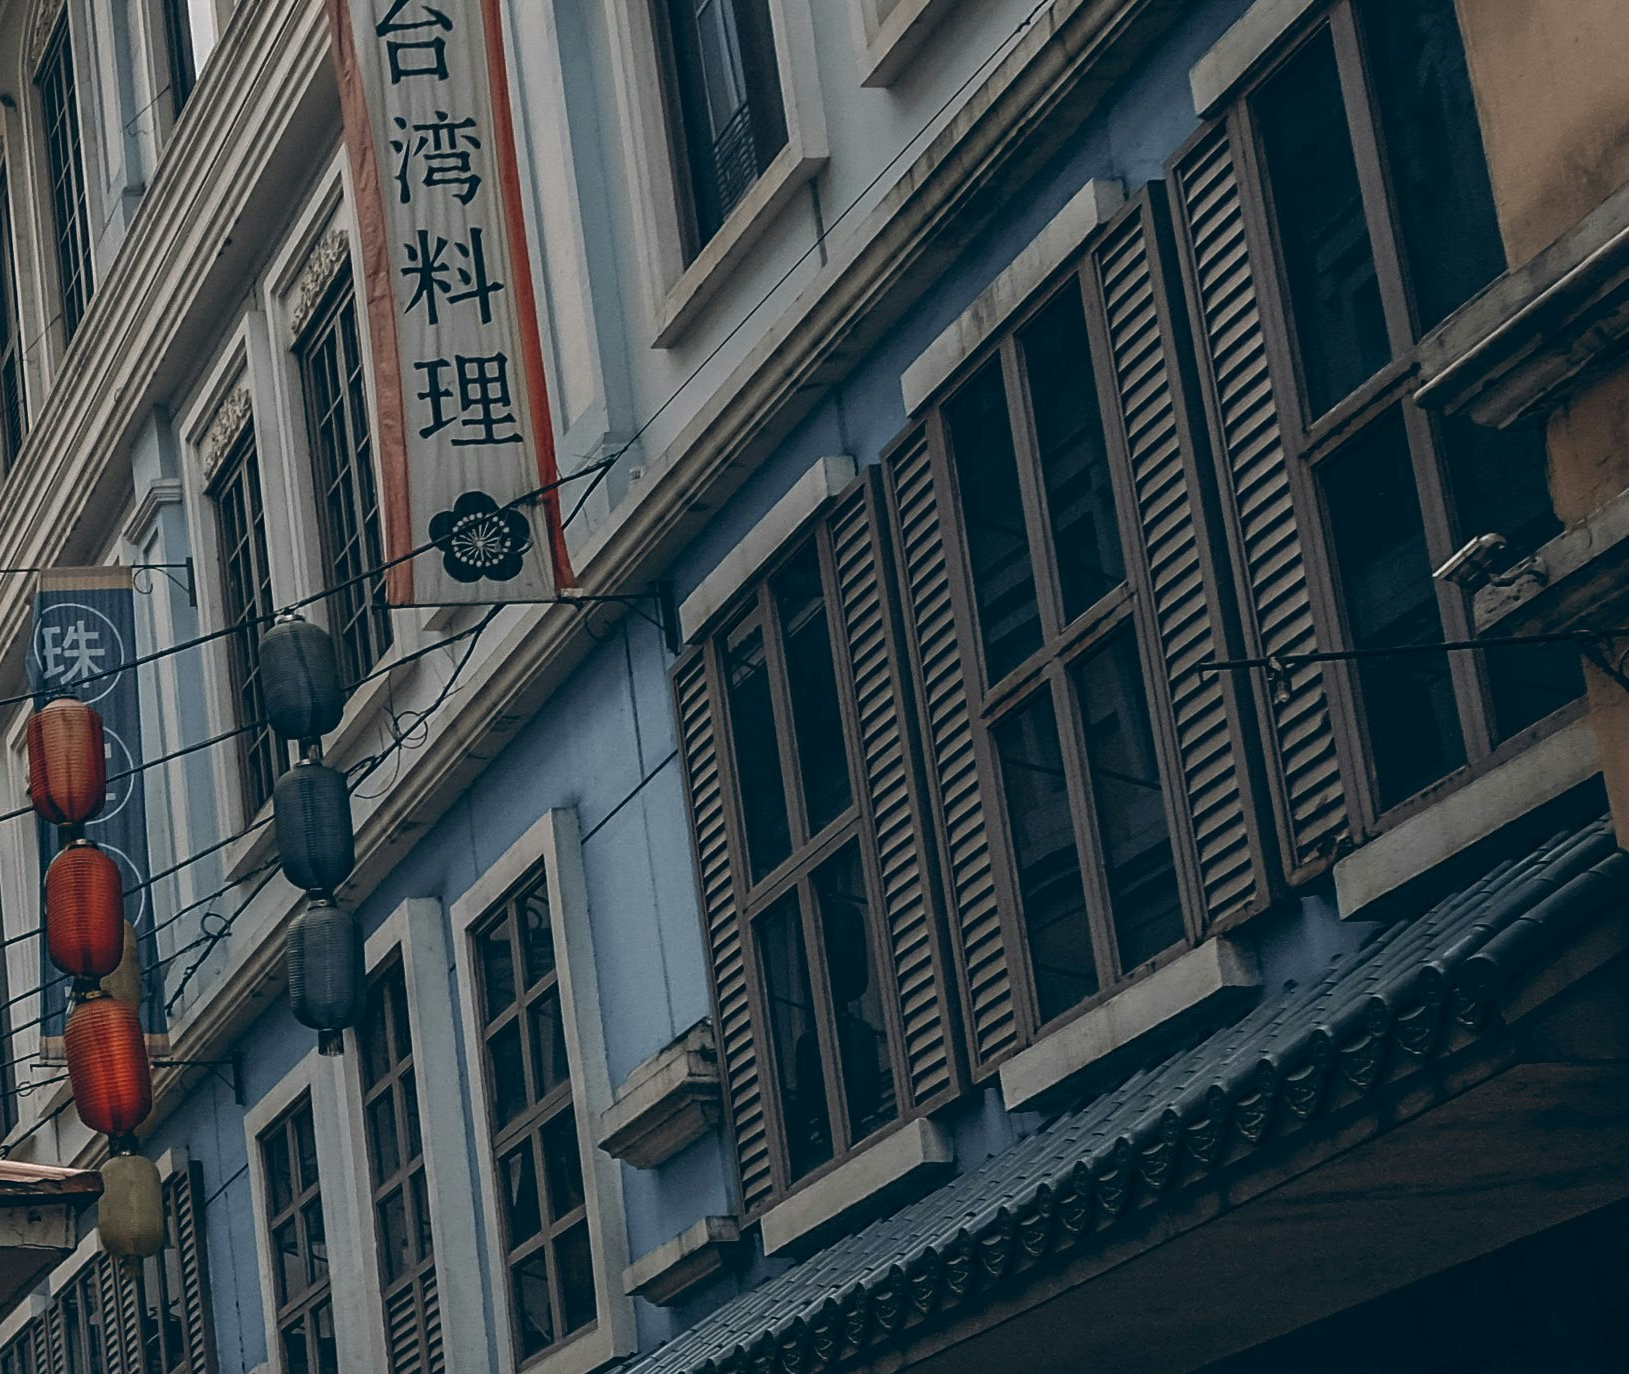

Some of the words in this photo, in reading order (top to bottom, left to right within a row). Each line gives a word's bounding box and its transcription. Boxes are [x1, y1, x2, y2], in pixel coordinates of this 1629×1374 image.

[376, 0, 524, 448] 台湾料理
[42, 619, 106, 689] 珠
